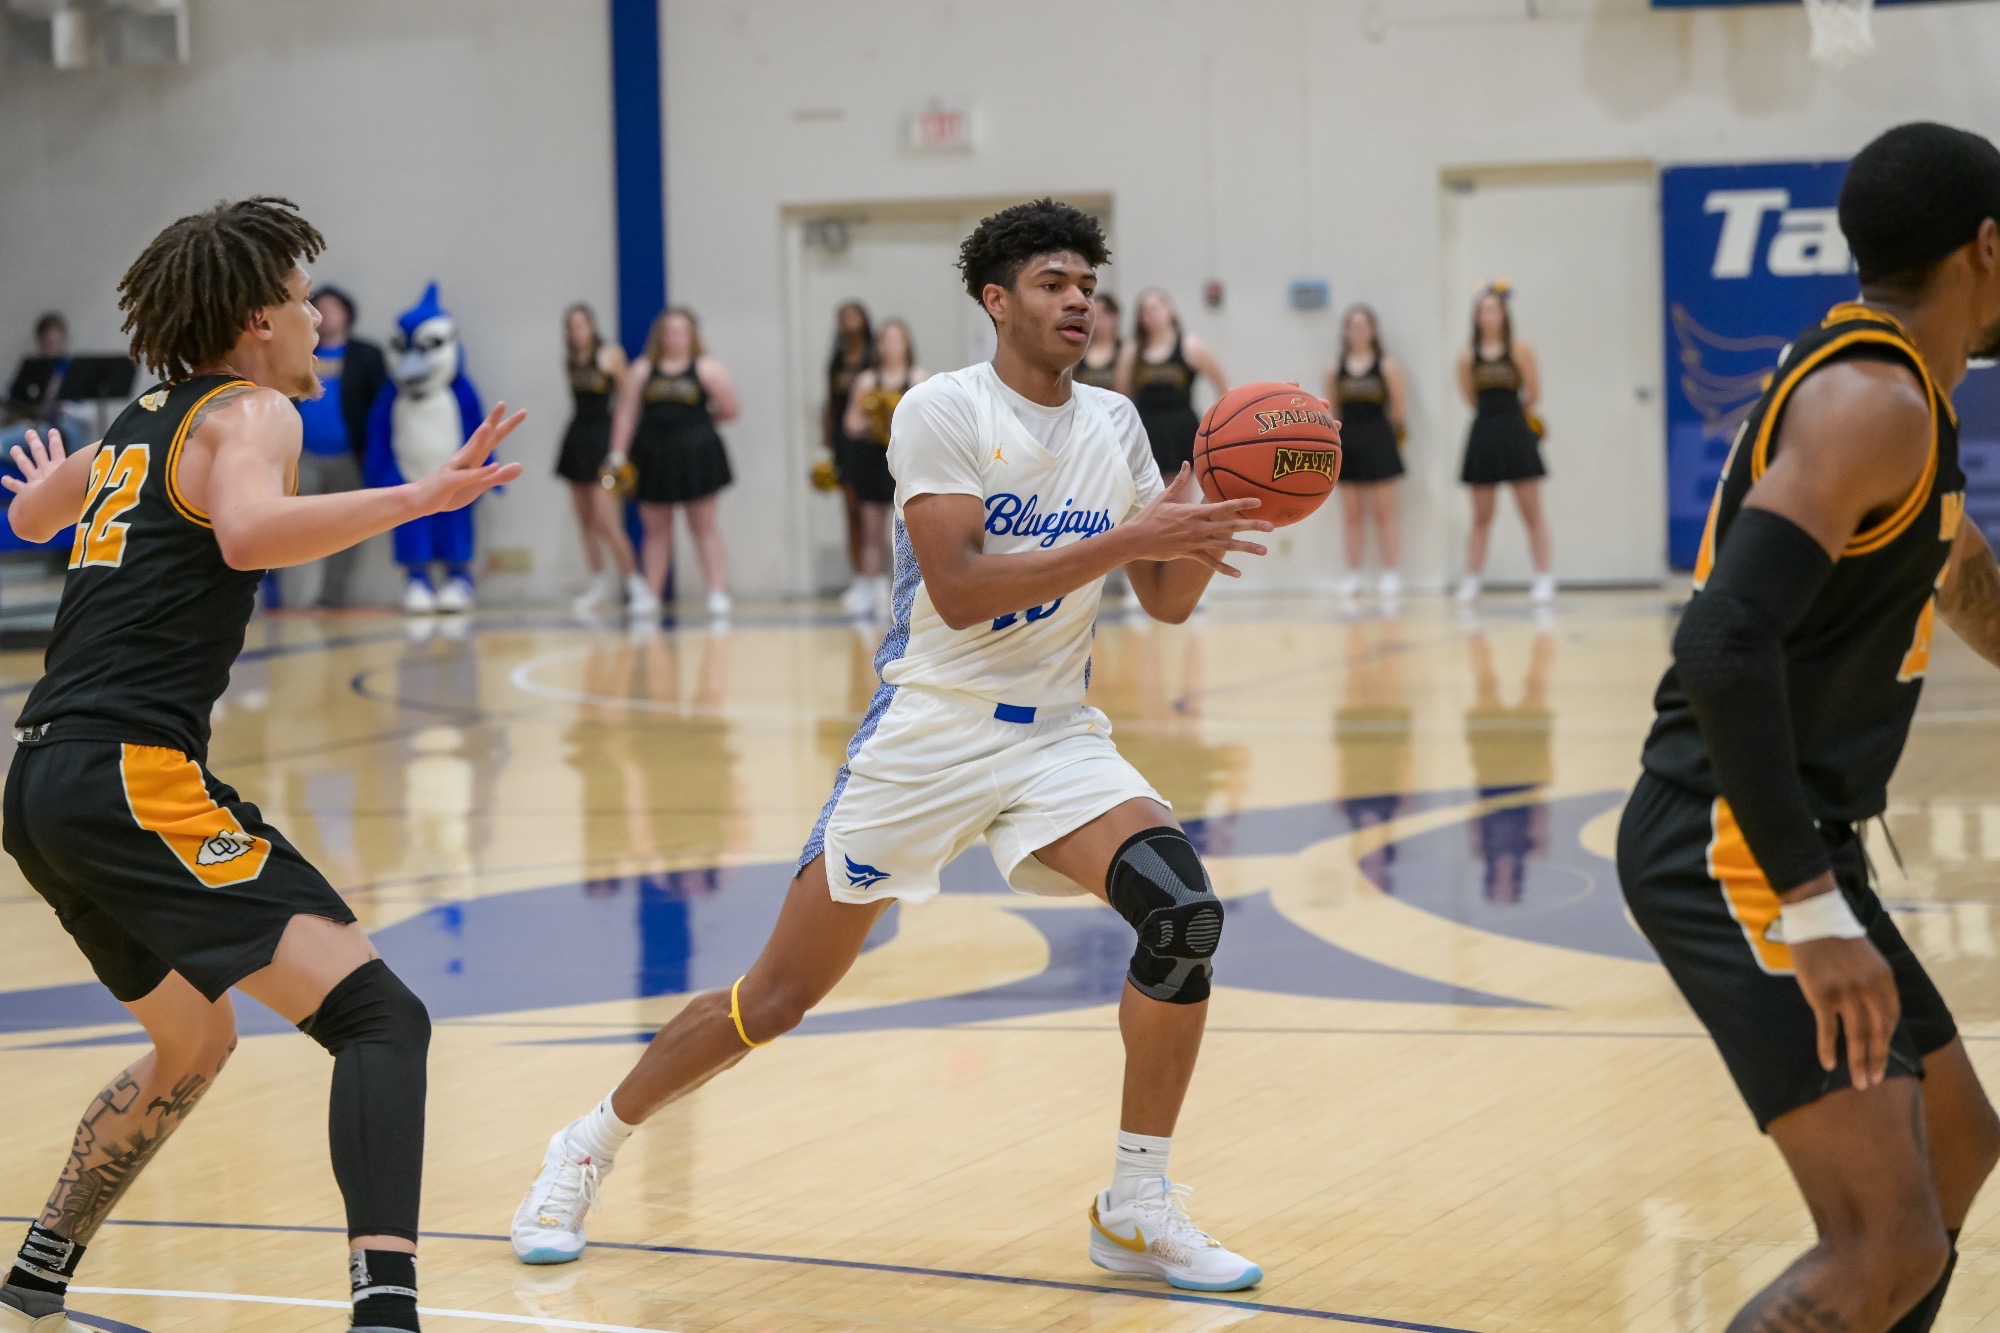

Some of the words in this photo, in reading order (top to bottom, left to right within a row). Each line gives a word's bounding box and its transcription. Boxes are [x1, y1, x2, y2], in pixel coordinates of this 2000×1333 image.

[1703, 187, 1859, 279] Ta
[1274, 449, 1336, 482] NAIA
[68, 444, 150, 570] 22
[985, 493, 1115, 548] Bluejays
